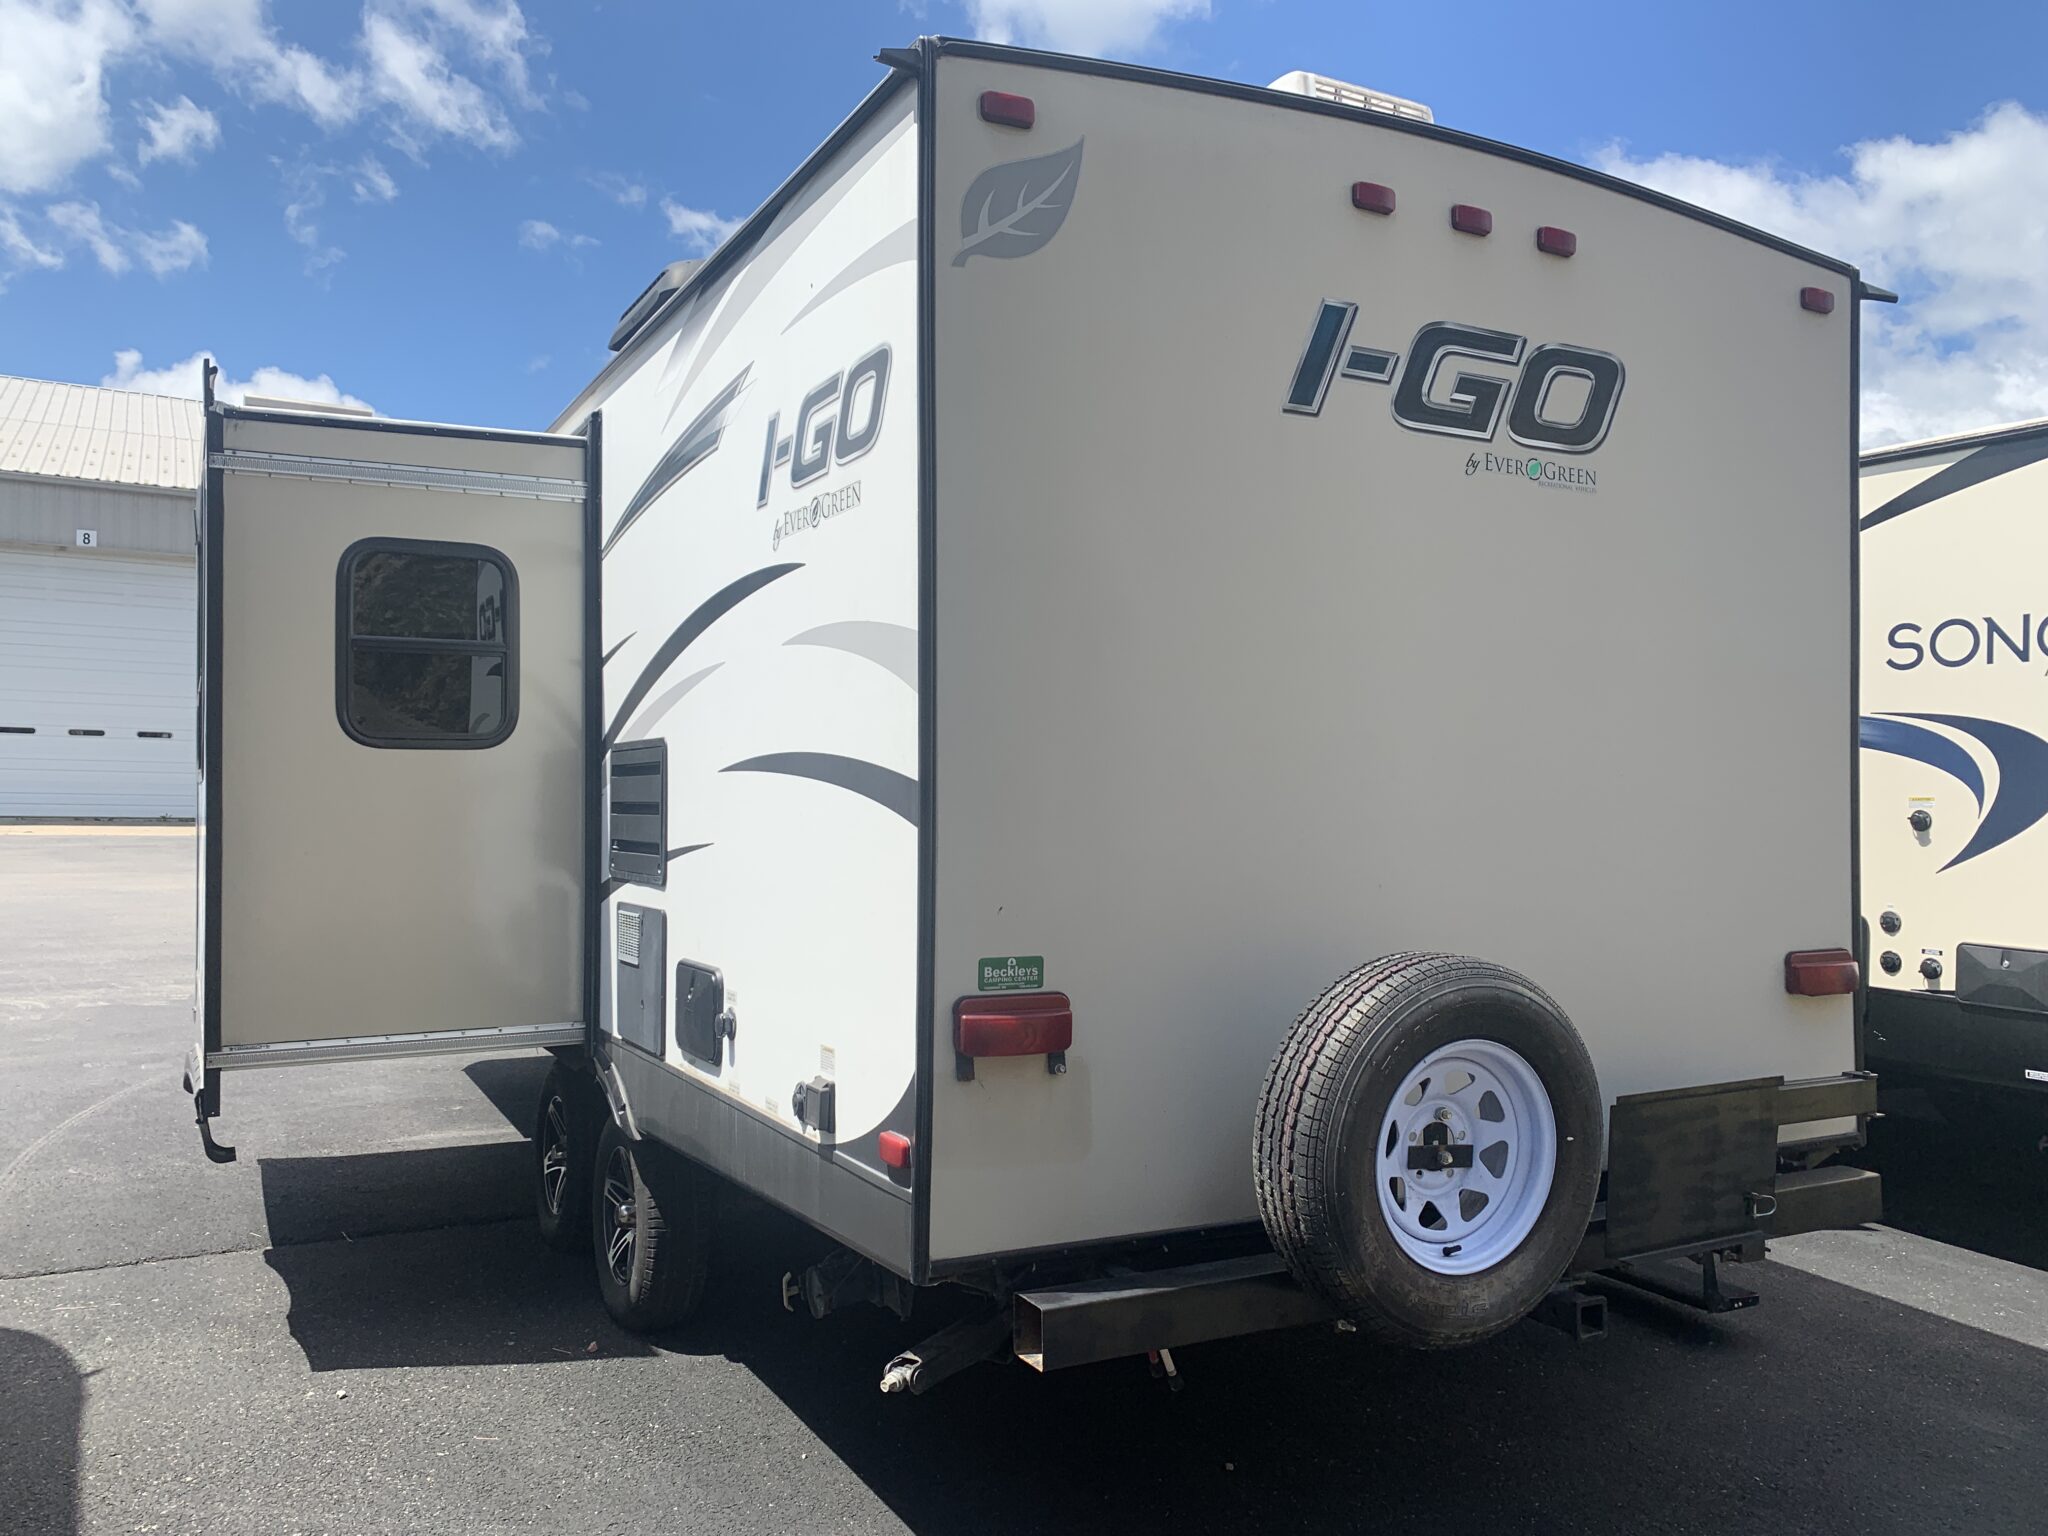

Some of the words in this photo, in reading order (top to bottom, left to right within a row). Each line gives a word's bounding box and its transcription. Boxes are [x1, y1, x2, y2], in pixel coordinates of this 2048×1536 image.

[1282, 297, 1626, 455] I-GO
[756, 342, 892, 512] I-GO
[1465, 452, 1481, 476] by
[83, 533, 90, 544] 8
[772, 518, 782, 552] by
